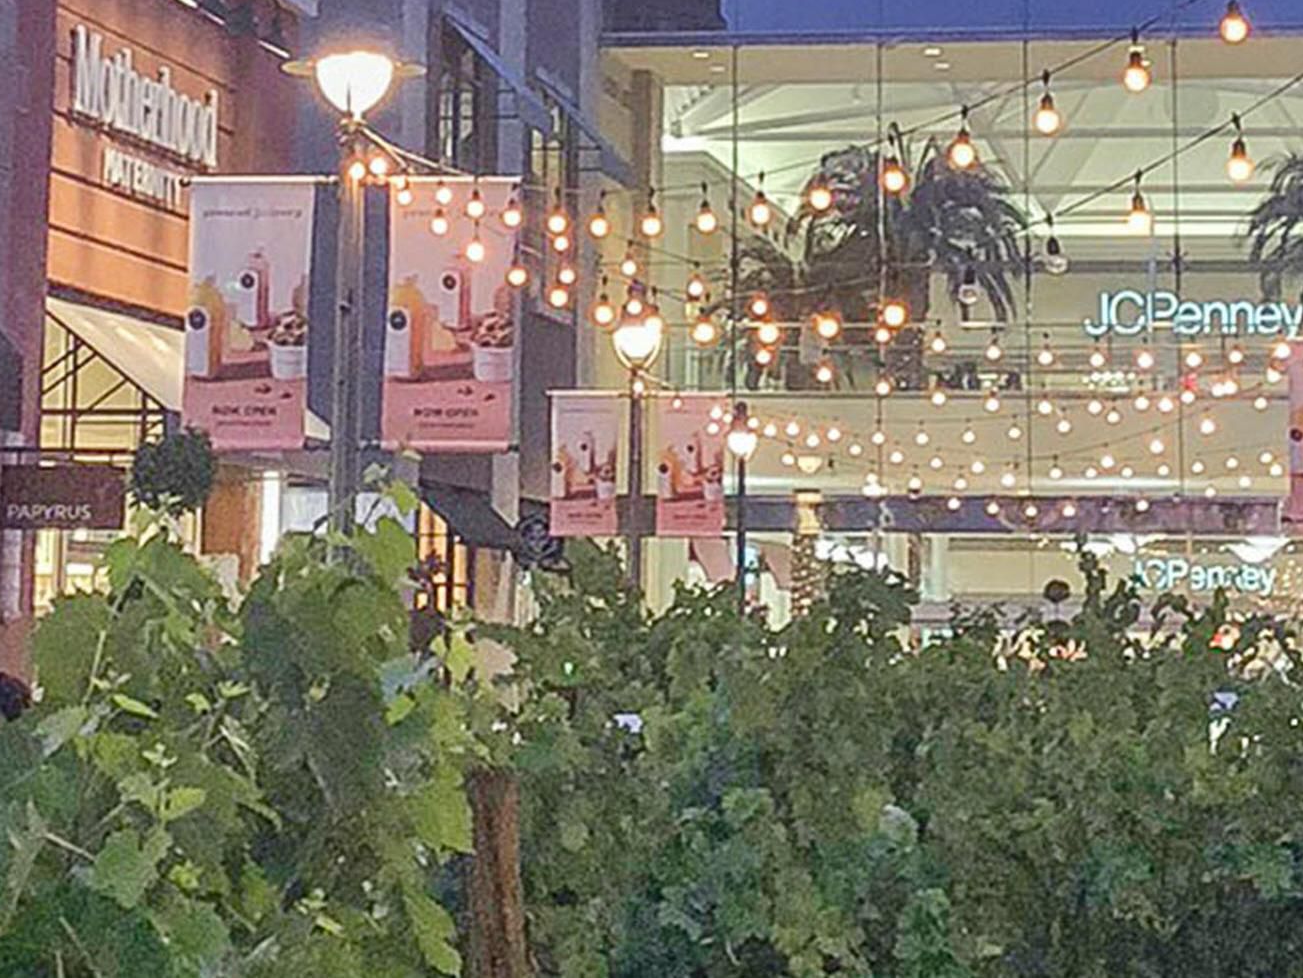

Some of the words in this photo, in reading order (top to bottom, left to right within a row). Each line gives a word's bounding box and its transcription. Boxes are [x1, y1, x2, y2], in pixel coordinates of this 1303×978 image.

[73, 24, 218, 167] Motherhood
[103, 145, 182, 210] MATERNITY
[1083, 289, 1303, 338] JCPenney
[6, 503, 92, 520] PAPYRUS
